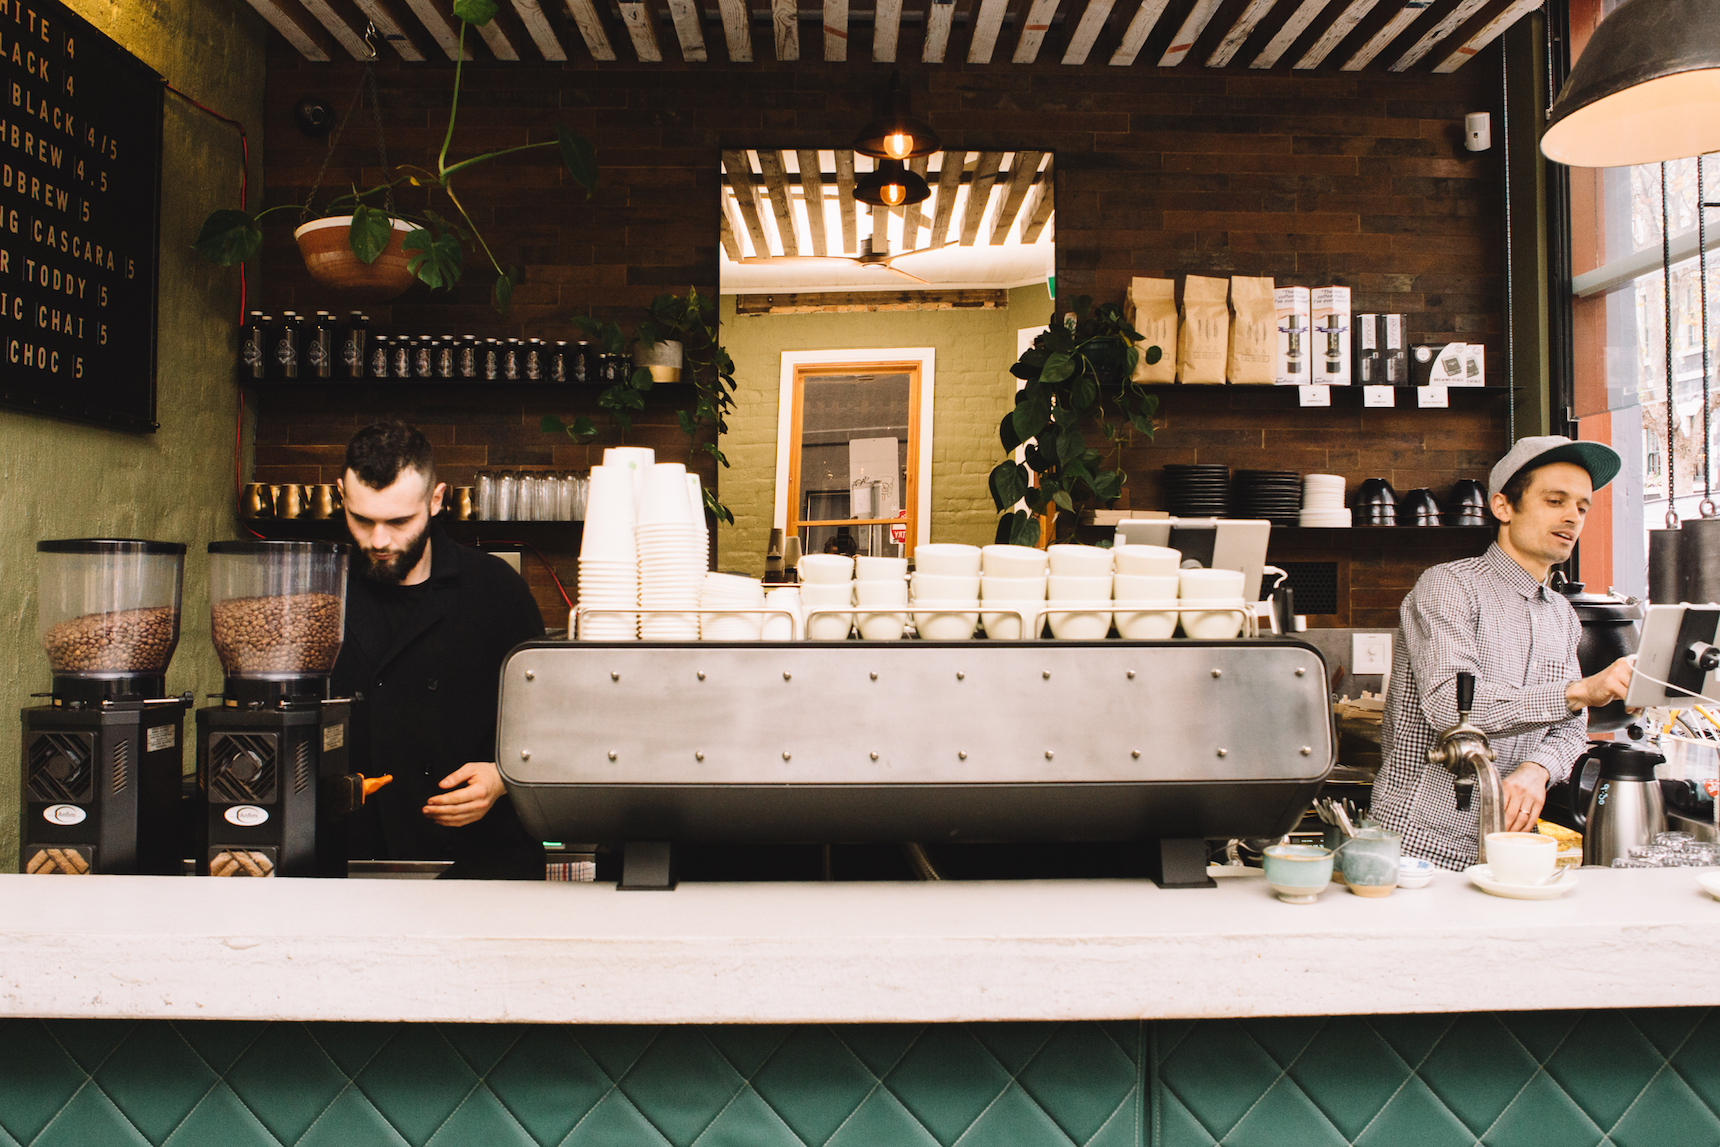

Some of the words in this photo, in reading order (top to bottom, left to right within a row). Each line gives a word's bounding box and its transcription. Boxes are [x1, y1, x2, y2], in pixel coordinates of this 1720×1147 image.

[0, 32, 49, 83] LACK
[66, 76, 74, 97] 4
[66, 38, 75, 59] 4
[12, 82, 75, 137] BLACK
[82, 200, 90, 222] 5
[33, 219, 115, 271] CASCARA
[128, 259, 135, 279] 5
[26, 258, 86, 299] TODDY
[100, 286, 108, 307] 5
[38, 305, 84, 339] CHAI
[100, 324, 107, 345] 5
[9, 339, 59, 374] CHOC
[75, 356, 84, 379] 5
